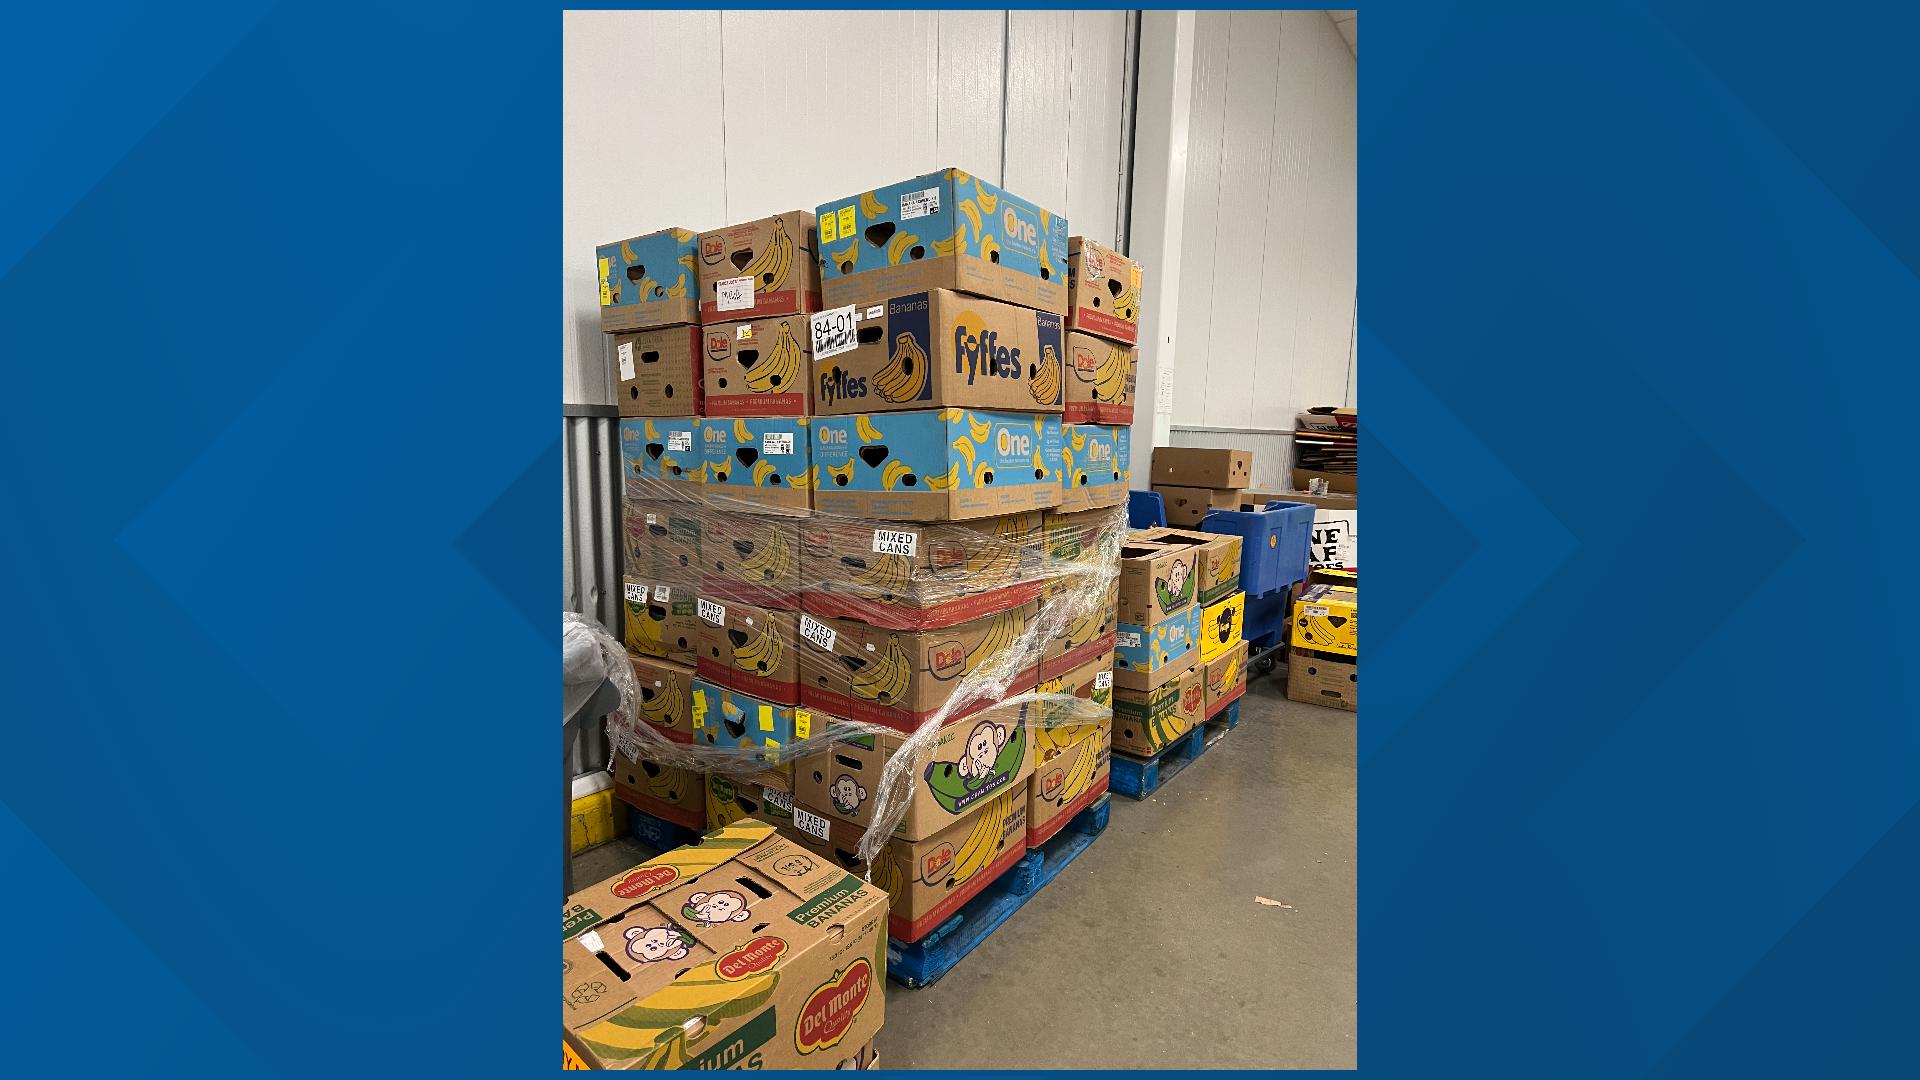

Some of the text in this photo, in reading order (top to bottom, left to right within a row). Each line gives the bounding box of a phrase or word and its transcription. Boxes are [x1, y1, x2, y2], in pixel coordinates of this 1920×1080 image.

[1004, 207, 1037, 246] One
[705, 241, 723, 254] Dole
[889, 300, 928, 315] Bananas
[814, 311, 852, 339] 84-01
[710, 336, 728, 349] Dole
[955, 325, 1022, 385] fyffes
[1077, 353, 1095, 368] Dole
[704, 426, 727, 443] One
[819, 426, 848, 445] One
[997, 427, 1030, 456] One
[1089, 438, 1111, 461] One
[878, 531, 913, 543] MIXED
[879, 542, 910, 554] CANS
[626, 584, 645, 594] MIXED
[627, 592, 643, 601] CANS
[700, 600, 722, 615] MIXED
[701, 609, 720, 623] CANS
[804, 617, 832, 639] MIXED
[804, 628, 828, 647] CANS
[1170, 624, 1185, 642] One
[935, 648, 962, 667] Dole
[1045, 772, 1063, 791] Dole
[767, 793, 792, 811] CANS
[797, 810, 826, 829] MIXED
[798, 821, 824, 838] CANS
[927, 848, 952, 874] Dole
[618, 869, 674, 896] Del Monte
[795, 889, 850, 922] Premium
[806, 889, 869, 929] BANANAS
[722, 939, 781, 975] Del Monte
[748, 953, 773, 970] Quality
[803, 973, 868, 1037] Del Monte
[823, 1007, 852, 1034] Quality
